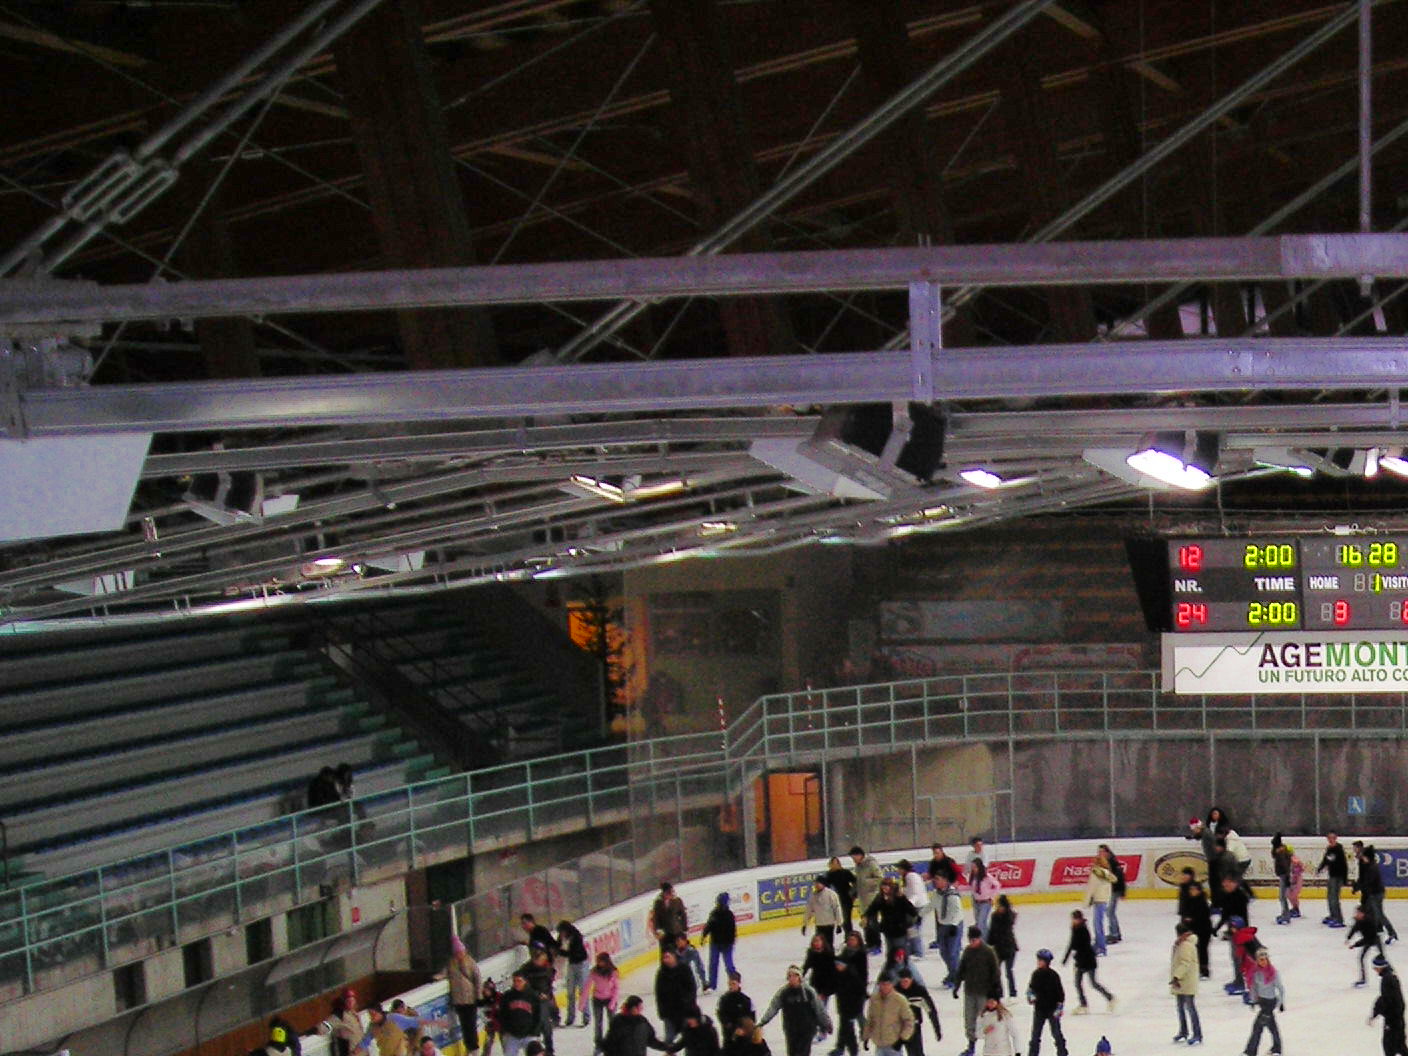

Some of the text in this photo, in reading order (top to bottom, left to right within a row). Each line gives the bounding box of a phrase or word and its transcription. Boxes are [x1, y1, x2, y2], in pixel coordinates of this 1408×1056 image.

[1180, 546, 1201, 567] 12
[1244, 545, 1293, 567] 2:00
[1174, 579, 1203, 592] NR.
[1254, 576, 1296, 591] TIME
[1308, 576, 1340, 590] HOME
[1177, 603, 1207, 624] 24
[1248, 602, 1297, 624] 2:00
[1258, 670, 1281, 684] UN
[1284, 669, 1347, 683] FUTURO
[1351, 669, 1388, 682] ALTO
